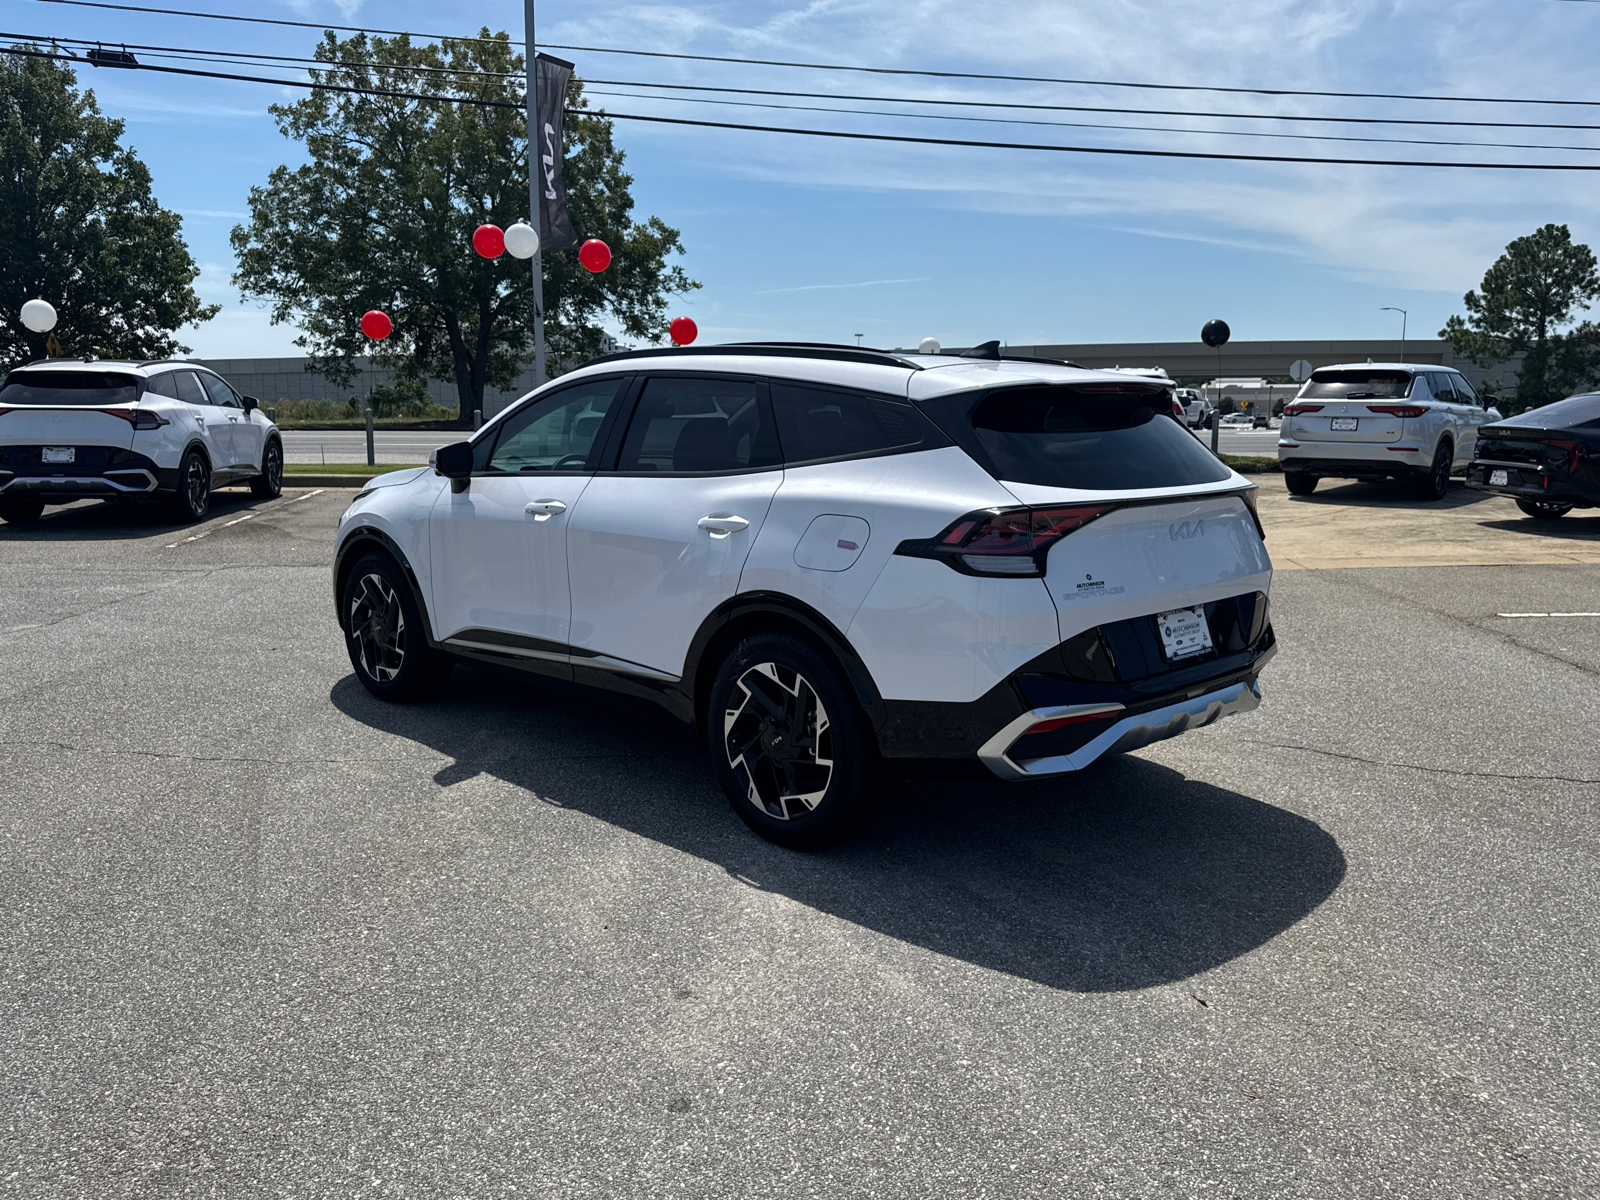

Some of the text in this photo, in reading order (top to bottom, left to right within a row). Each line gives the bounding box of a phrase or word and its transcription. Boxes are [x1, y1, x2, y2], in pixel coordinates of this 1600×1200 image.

[1168, 519, 1206, 541] KIA
[1076, 580, 1105, 589] HUTCHINSON
[1063, 585, 1126, 601] SPORTAGE
[1172, 621, 1201, 634] HUTCHINSON
